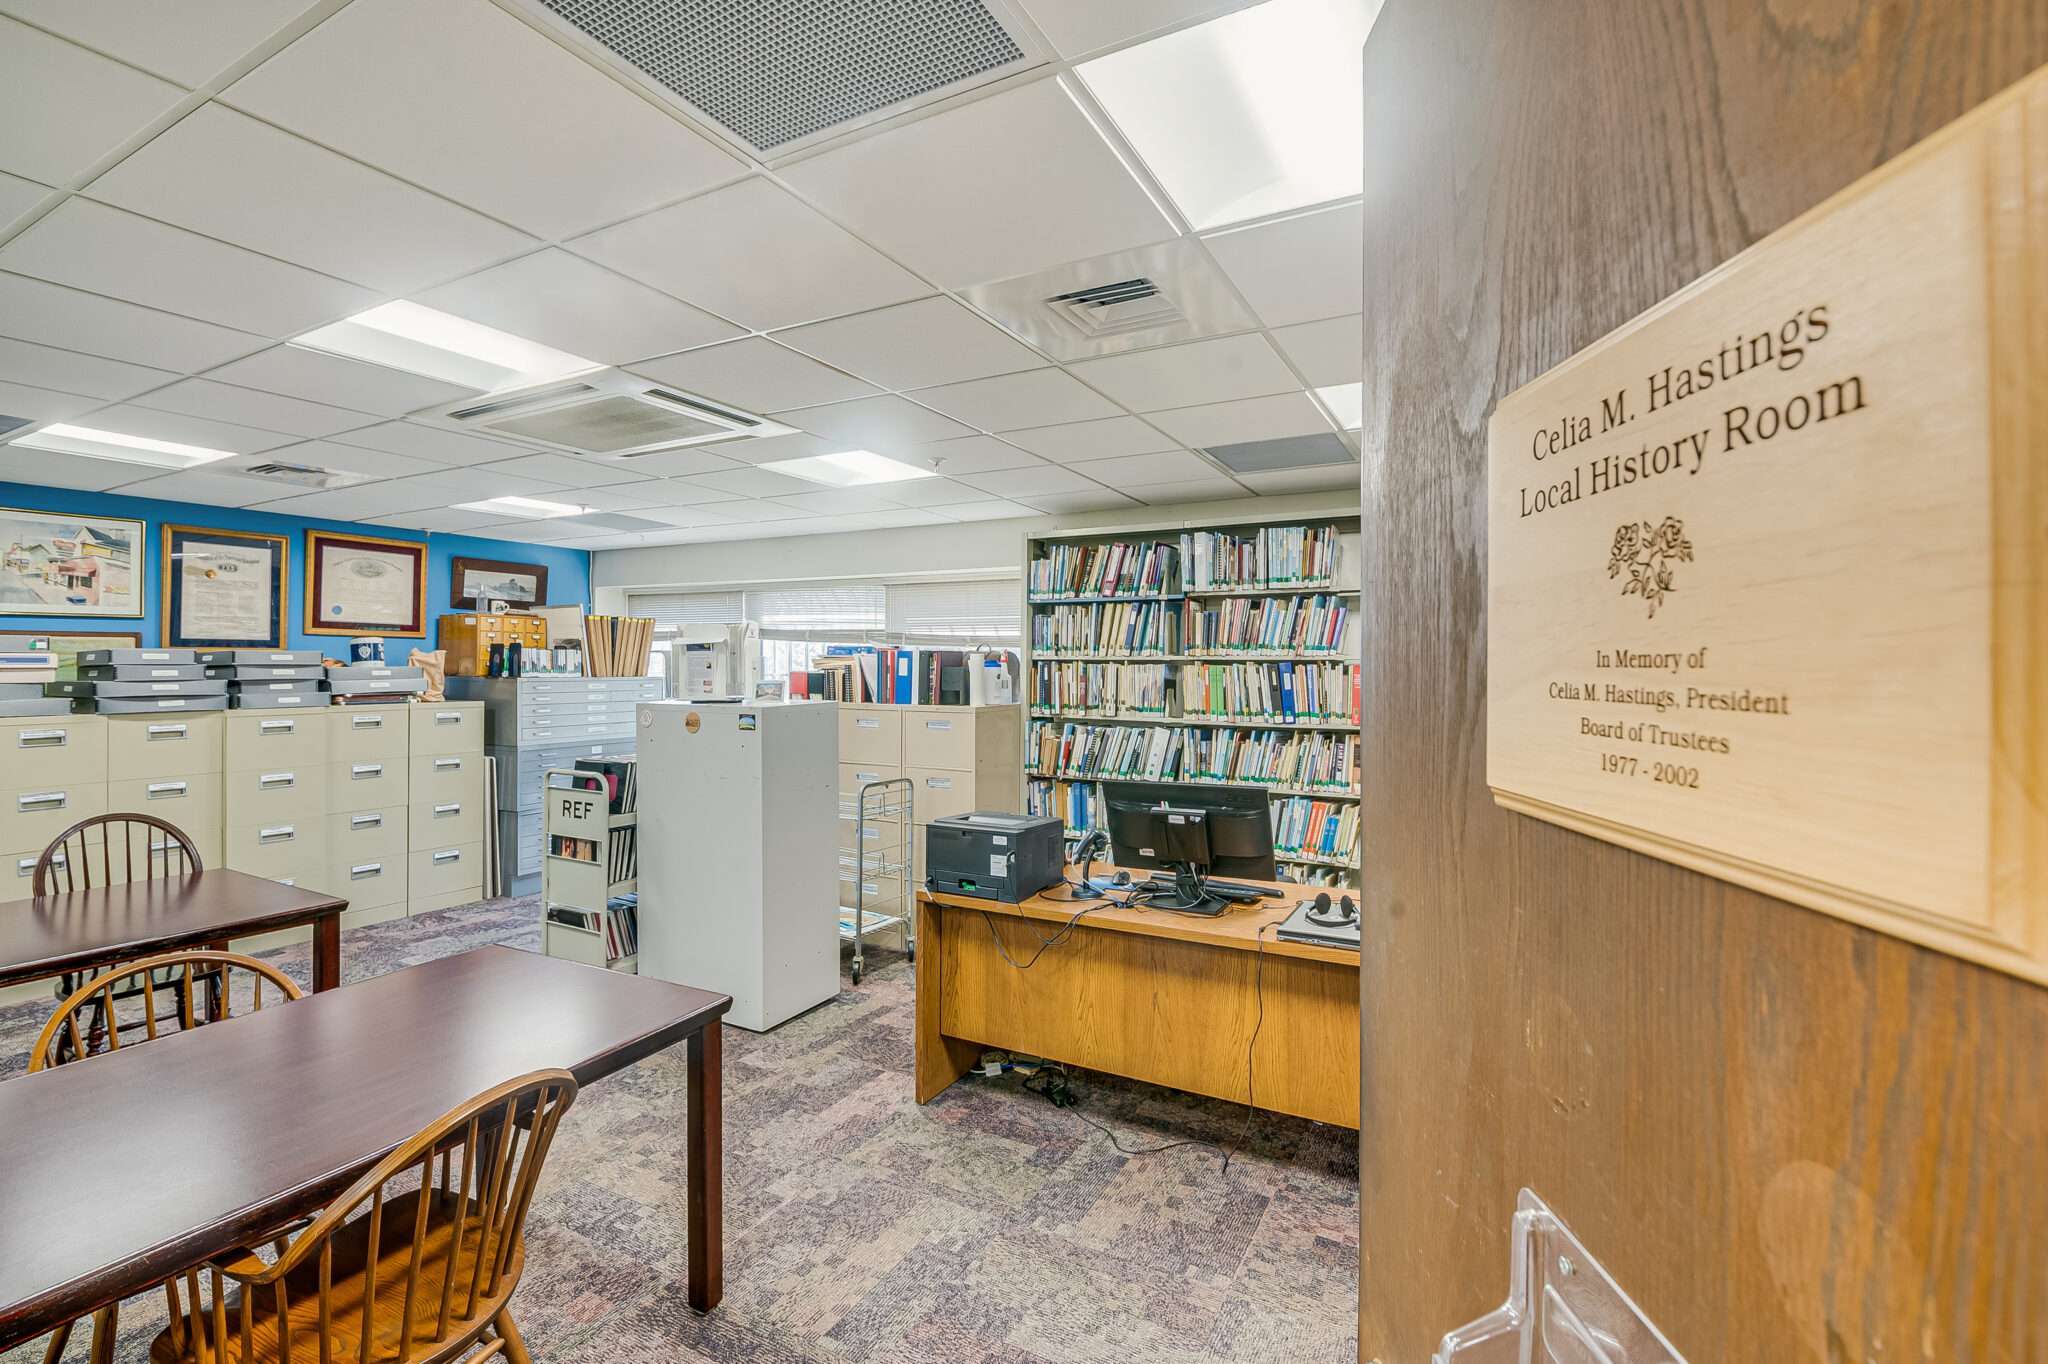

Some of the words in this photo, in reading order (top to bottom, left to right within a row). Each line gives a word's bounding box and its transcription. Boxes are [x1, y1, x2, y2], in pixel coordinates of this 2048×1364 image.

[1532, 413, 1592, 461] Celia
[1599, 390, 1635, 434] M.
[1646, 304, 1830, 414] Hastings
[1520, 469, 1581, 519] Local
[1590, 430, 1711, 497] History
[1722, 375, 1869, 453] Room
[1595, 650, 1610, 669] In
[1615, 650, 1682, 674] Memory
[1687, 647, 1708, 669] of
[1549, 682, 1580, 701] Celia
[1584, 684, 1600, 701] M.
[1604, 684, 1680, 712] Hastings,
[1686, 688, 1790, 715] President
[1580, 717, 1624, 740] Board
[1628, 724, 1645, 743] of
[1649, 725, 1730, 754] Trustees
[1601, 754, 1638, 777] 1977
[1653, 763, 1700, 789] 2002
[562, 799, 594, 819] REF
